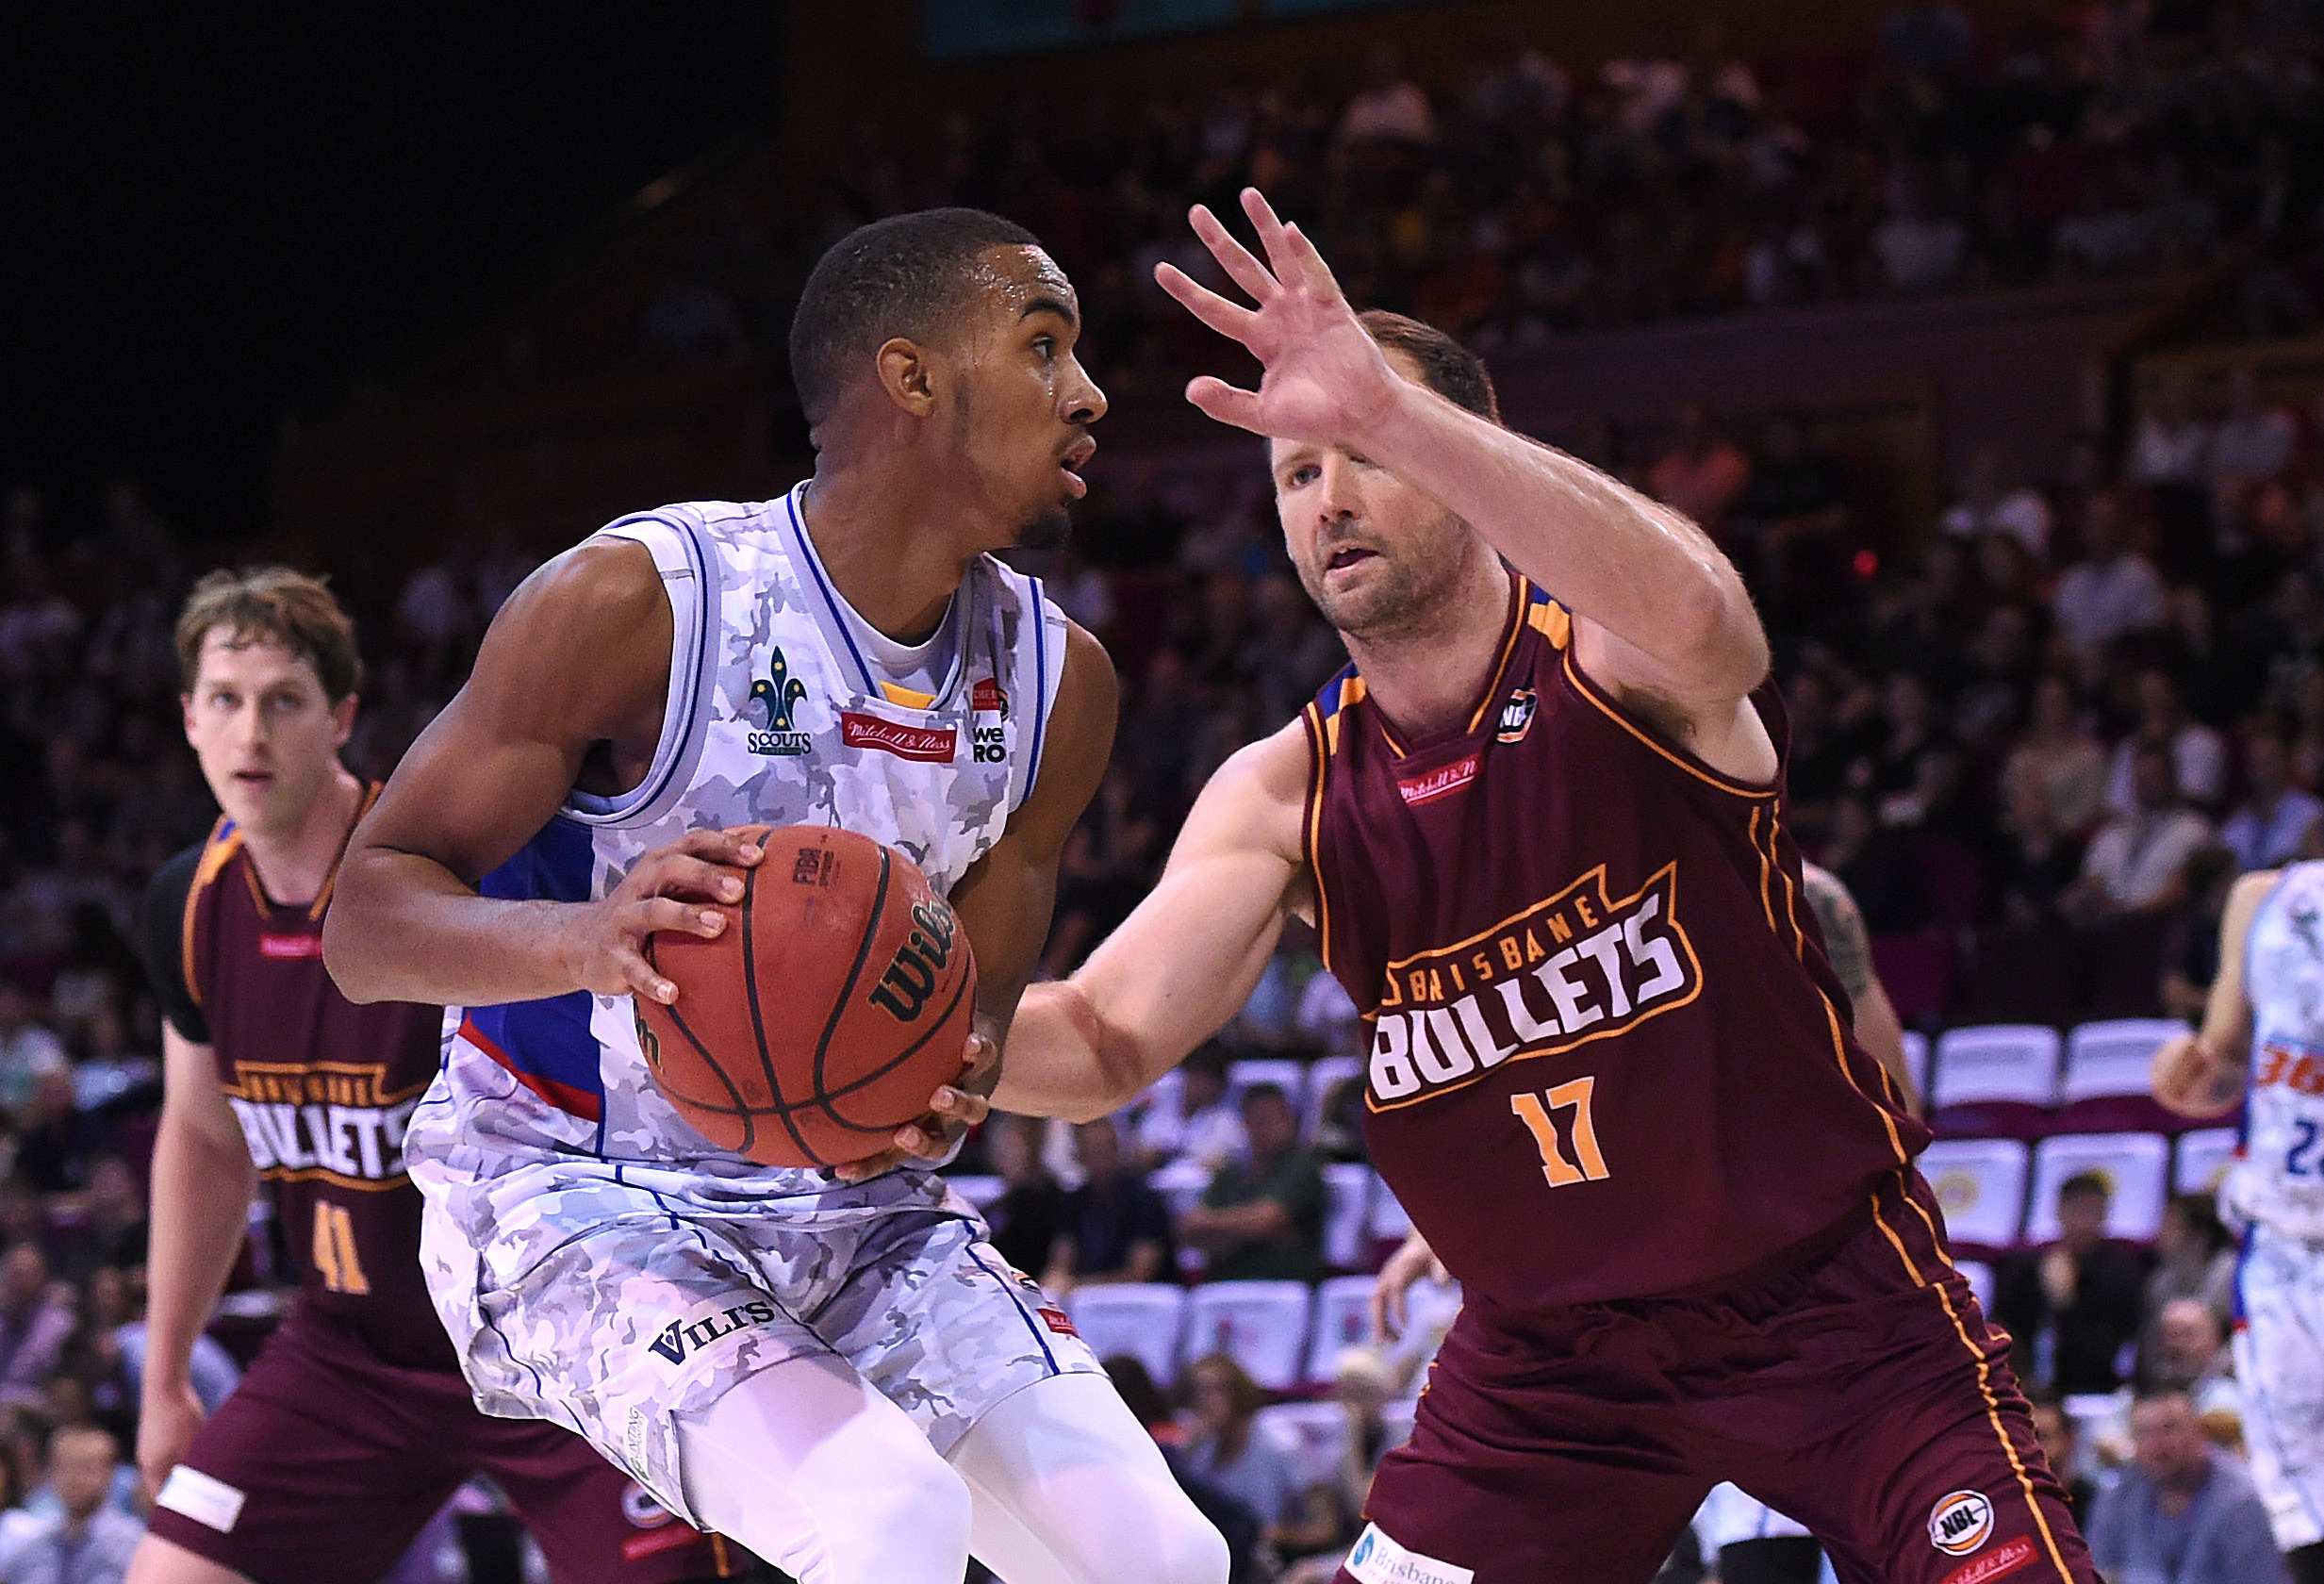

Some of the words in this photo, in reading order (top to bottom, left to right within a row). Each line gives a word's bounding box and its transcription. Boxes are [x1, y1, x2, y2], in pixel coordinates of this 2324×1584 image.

[747, 733, 812, 754] SCOUTS
[849, 721, 907, 745] Mitchell
[905, 734, 916, 748] &
[1500, 701, 1526, 727] NB
[1409, 895, 1600, 1002] BRISBANE
[1369, 892, 1686, 1100] BULLETS
[1510, 1075, 1612, 1189] 17
[313, 1198, 371, 1295] 41
[648, 1300, 776, 1366] VILI'S
[1939, 1505, 1980, 1540] NBL
